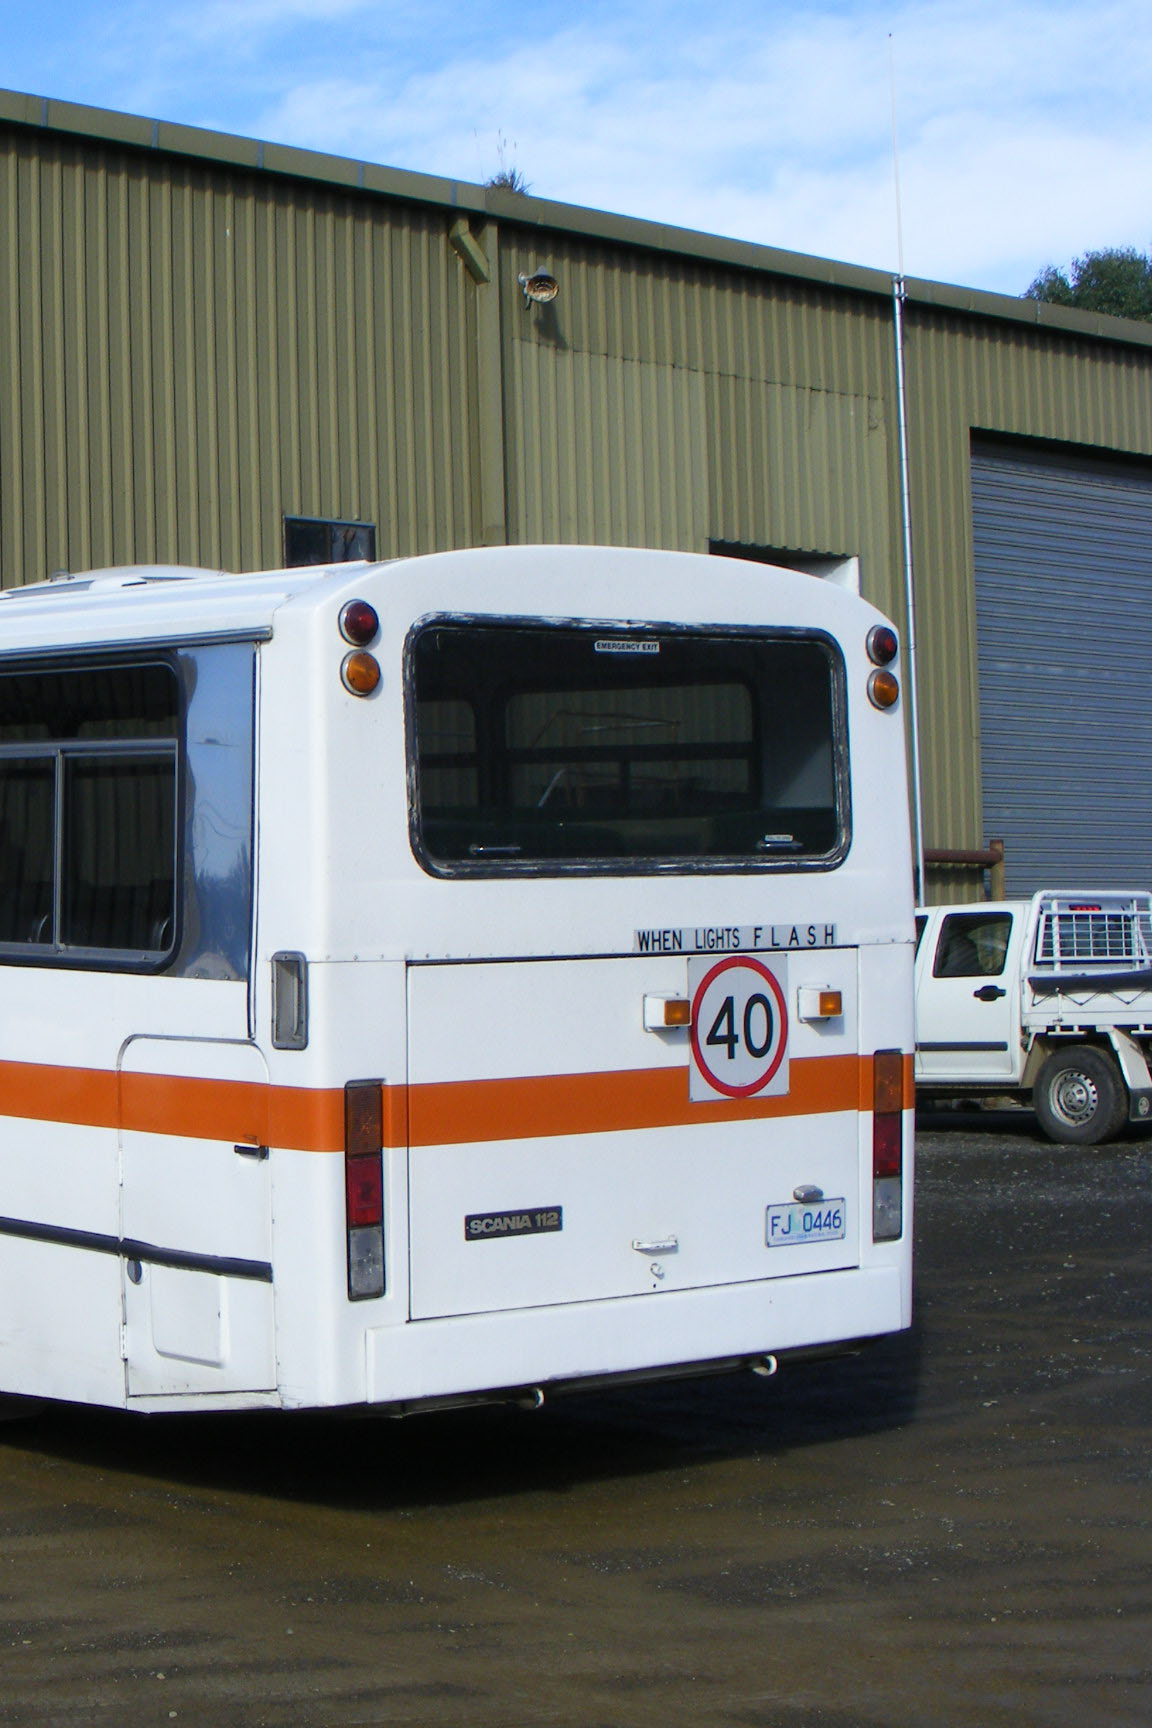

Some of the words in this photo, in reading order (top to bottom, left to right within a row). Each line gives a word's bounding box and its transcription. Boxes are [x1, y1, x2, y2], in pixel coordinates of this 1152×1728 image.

[596, 642, 640, 651] EMERGENCY
[642, 643, 658, 651] EXIT
[638, 929, 682, 951] WHEN
[695, 928, 740, 949] LIGHTS
[754, 925, 835, 947] FLASH
[706, 993, 774, 1060] 40
[470, 1215, 532, 1234] SCANIA
[535, 1211, 559, 1227] 112
